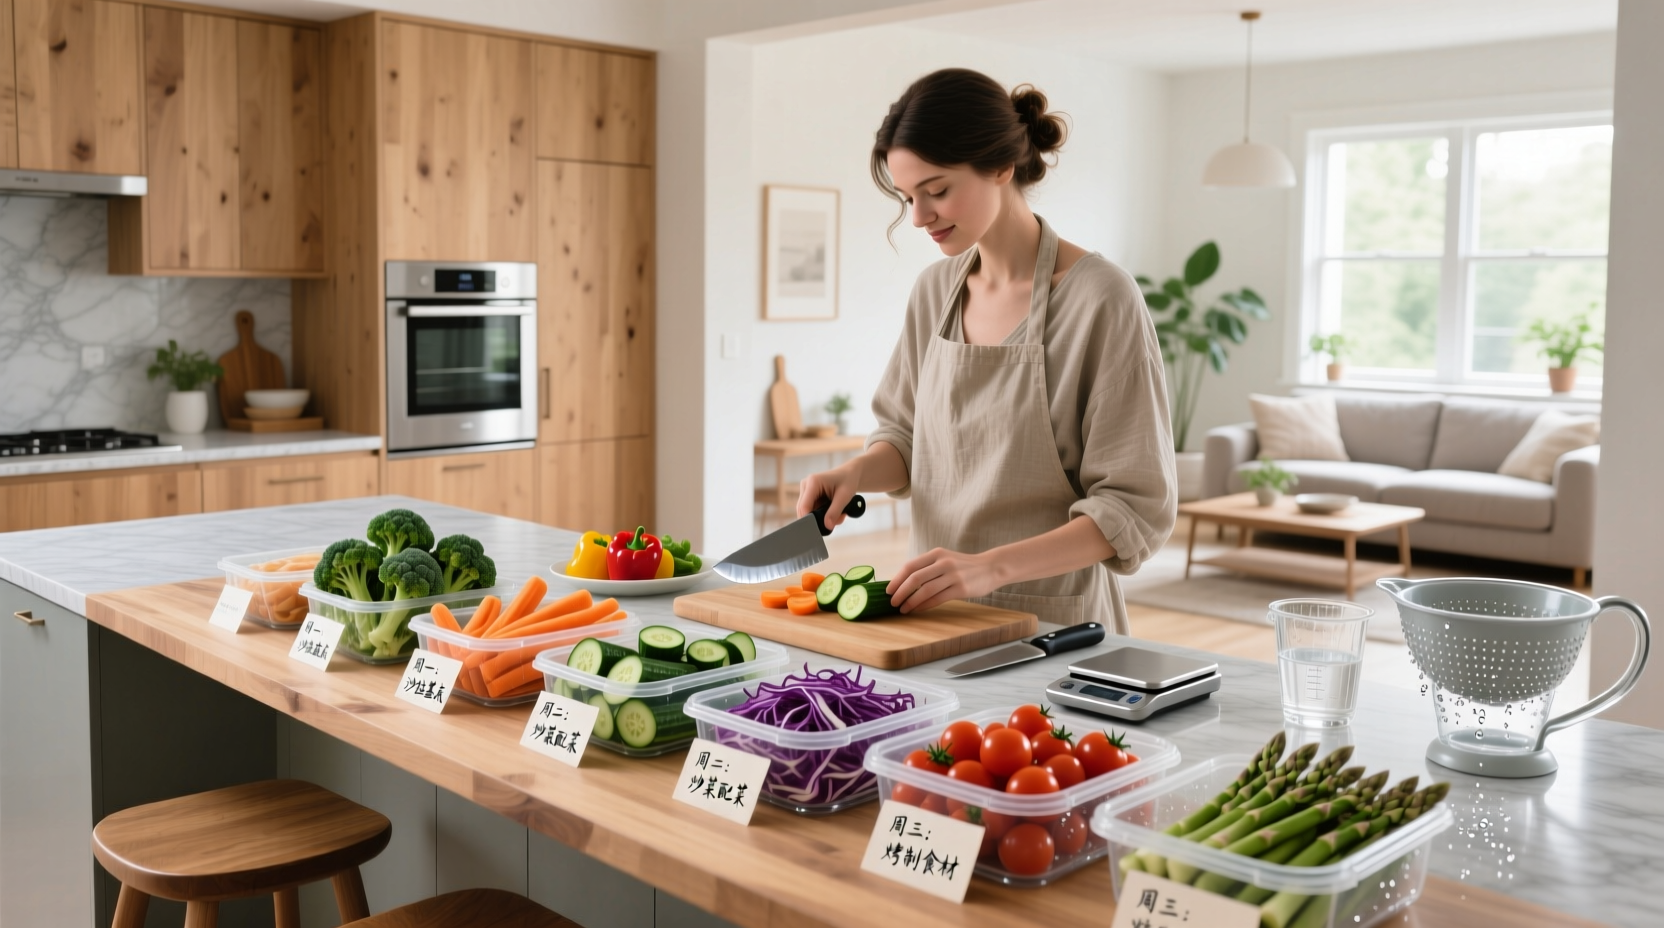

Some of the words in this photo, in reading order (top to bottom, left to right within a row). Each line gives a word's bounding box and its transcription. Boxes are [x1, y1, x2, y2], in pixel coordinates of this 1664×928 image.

[540, 701, 569, 720] 周二：
[695, 751, 730, 772] 周二：
[688, 774, 748, 808] 炒菜配菜
[889, 816, 931, 841] 周三：
[881, 842, 959, 881] 烤制食材
[1136, 889, 1190, 922] 周三：
